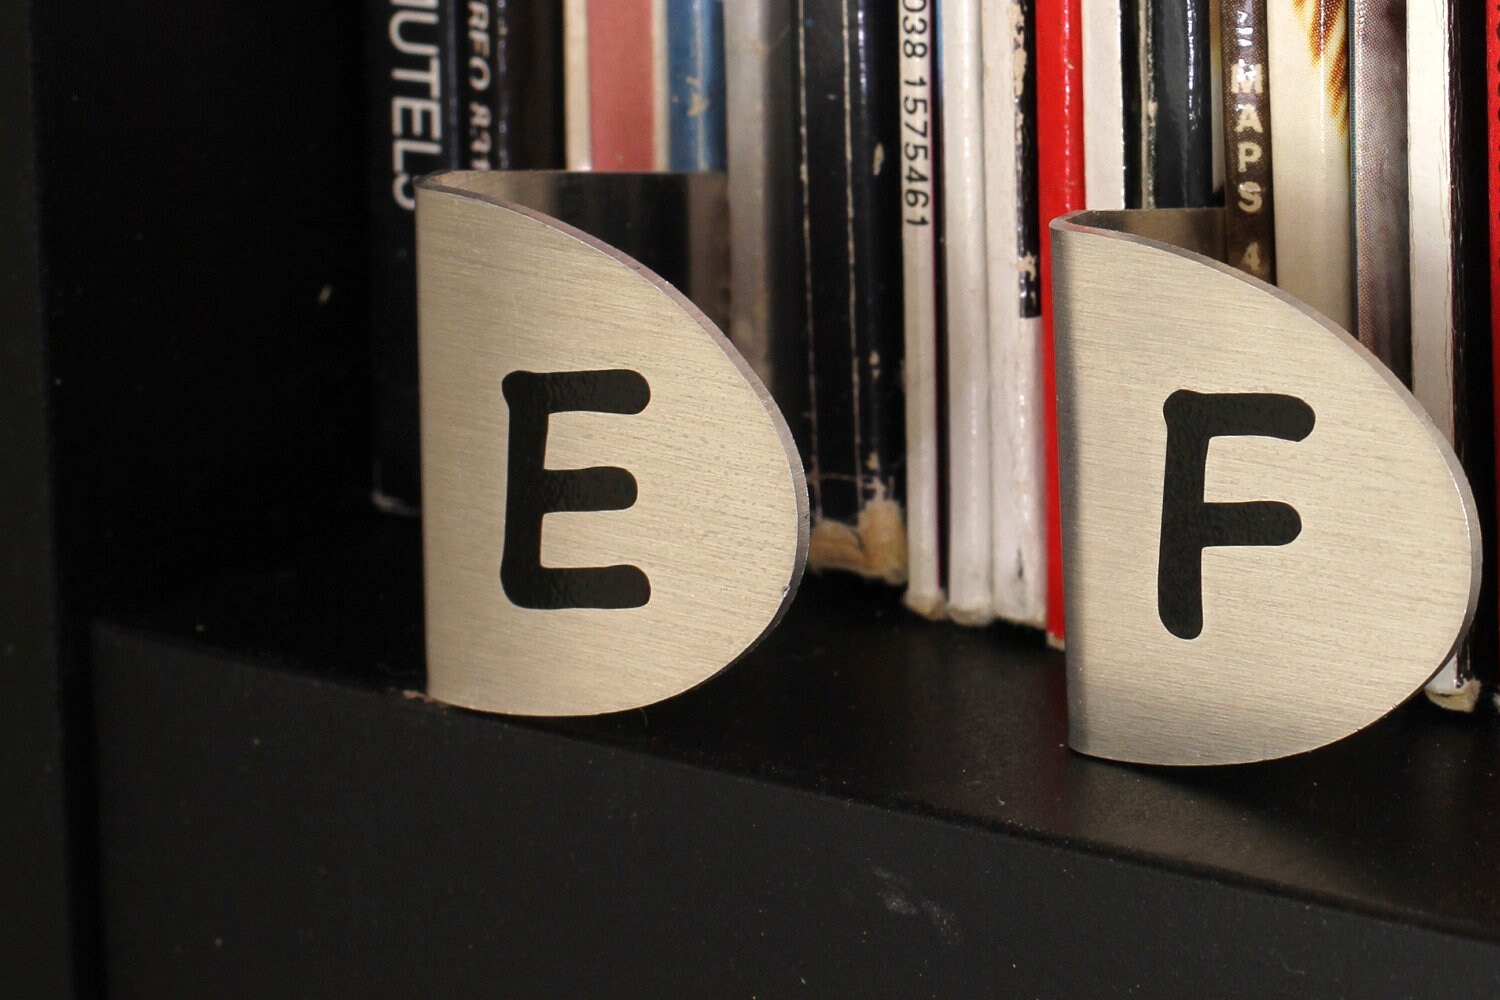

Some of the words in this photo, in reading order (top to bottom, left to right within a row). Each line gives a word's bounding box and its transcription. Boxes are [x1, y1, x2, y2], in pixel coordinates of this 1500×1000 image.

[902, 75, 930, 228] 1575461
[1231, 61, 1265, 214] MAPS
[500, 368, 652, 610] E
[1157, 388, 1317, 641] F
